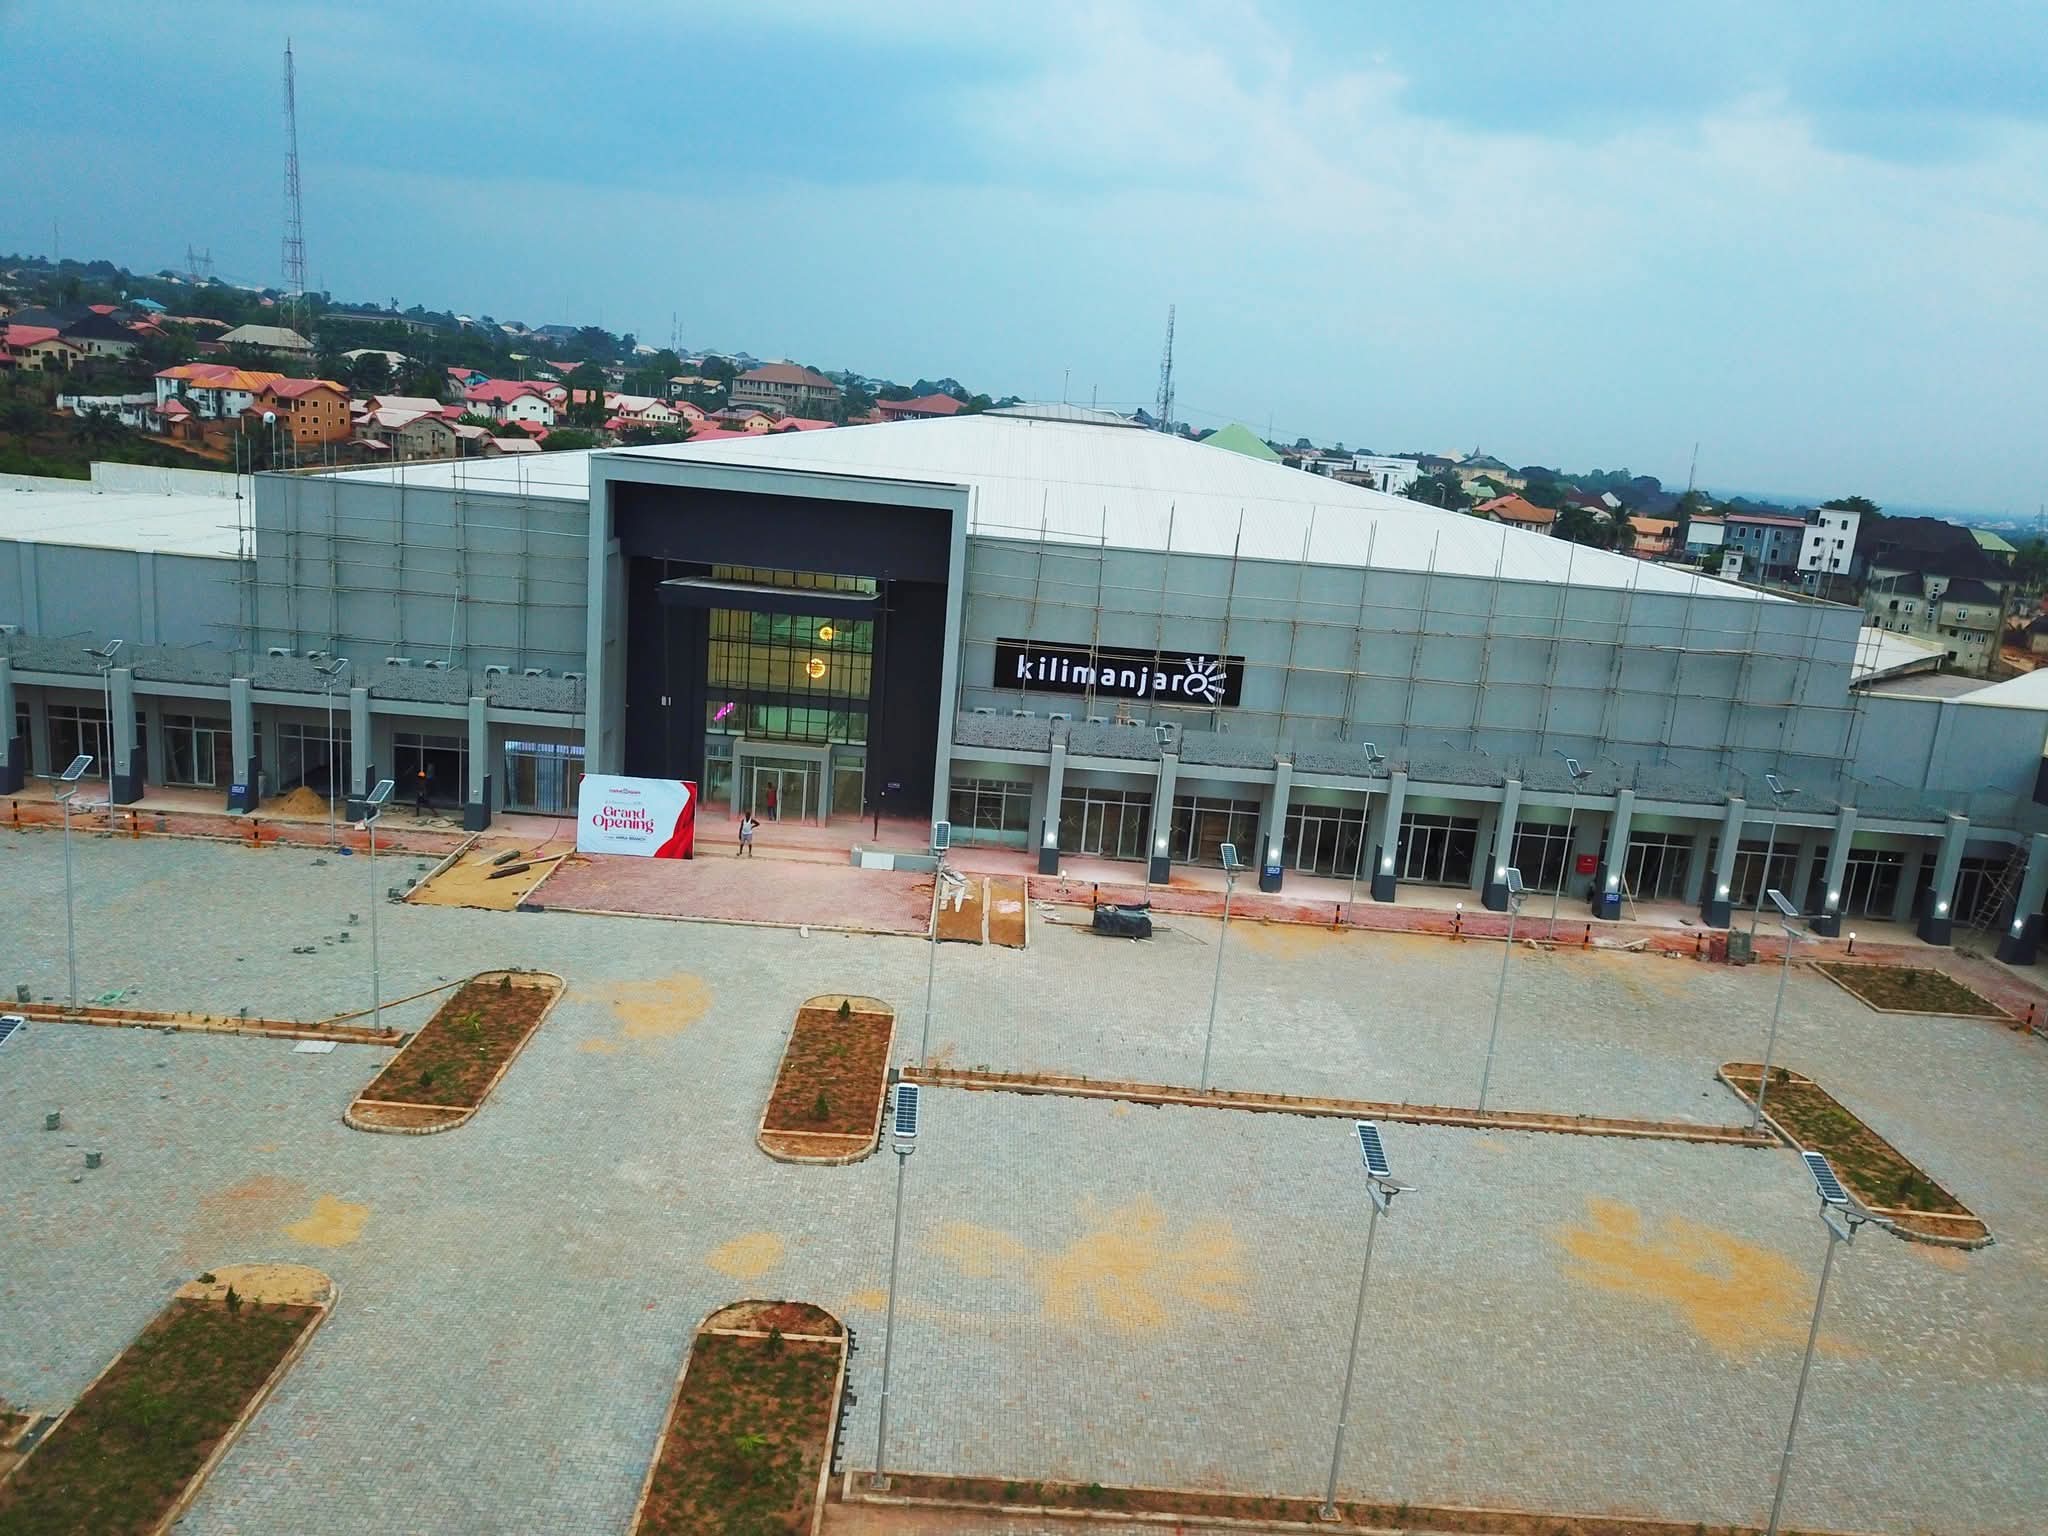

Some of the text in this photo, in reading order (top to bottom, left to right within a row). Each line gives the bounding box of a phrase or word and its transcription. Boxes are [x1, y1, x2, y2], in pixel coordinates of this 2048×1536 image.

[1016, 654, 1227, 703] kilimanjaro
[603, 805, 645, 819] Grand
[592, 814, 654, 833] Opening
